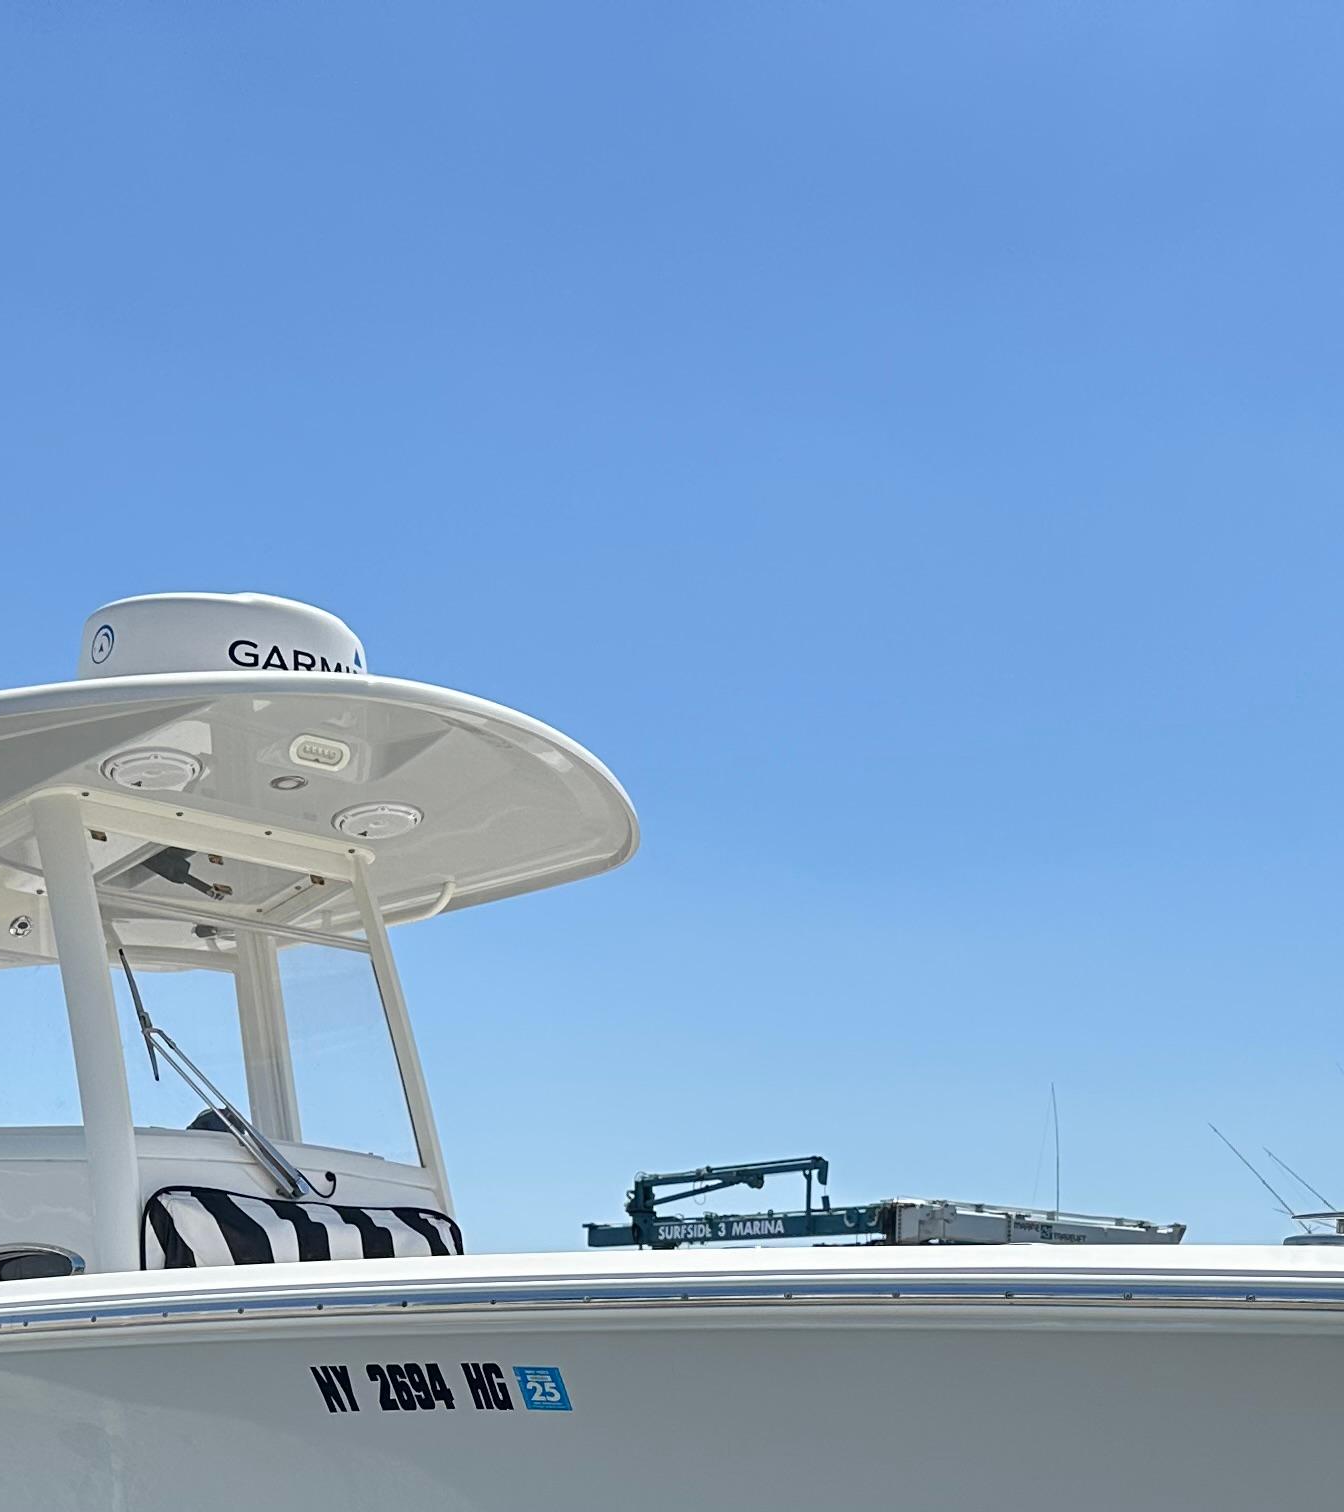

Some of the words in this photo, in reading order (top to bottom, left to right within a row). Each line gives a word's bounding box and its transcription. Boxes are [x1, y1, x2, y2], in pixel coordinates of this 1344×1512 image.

[228, 640, 358, 674] GARM
[658, 1224, 712, 1240] SURFSIDE
[718, 1222, 726, 1237] 3
[731, 1220, 784, 1236] MARINA
[309, 1365, 360, 1413] NY
[365, 1362, 456, 1411] 2694
[460, 1362, 514, 1411] HG
[526, 1381, 561, 1402] 25
